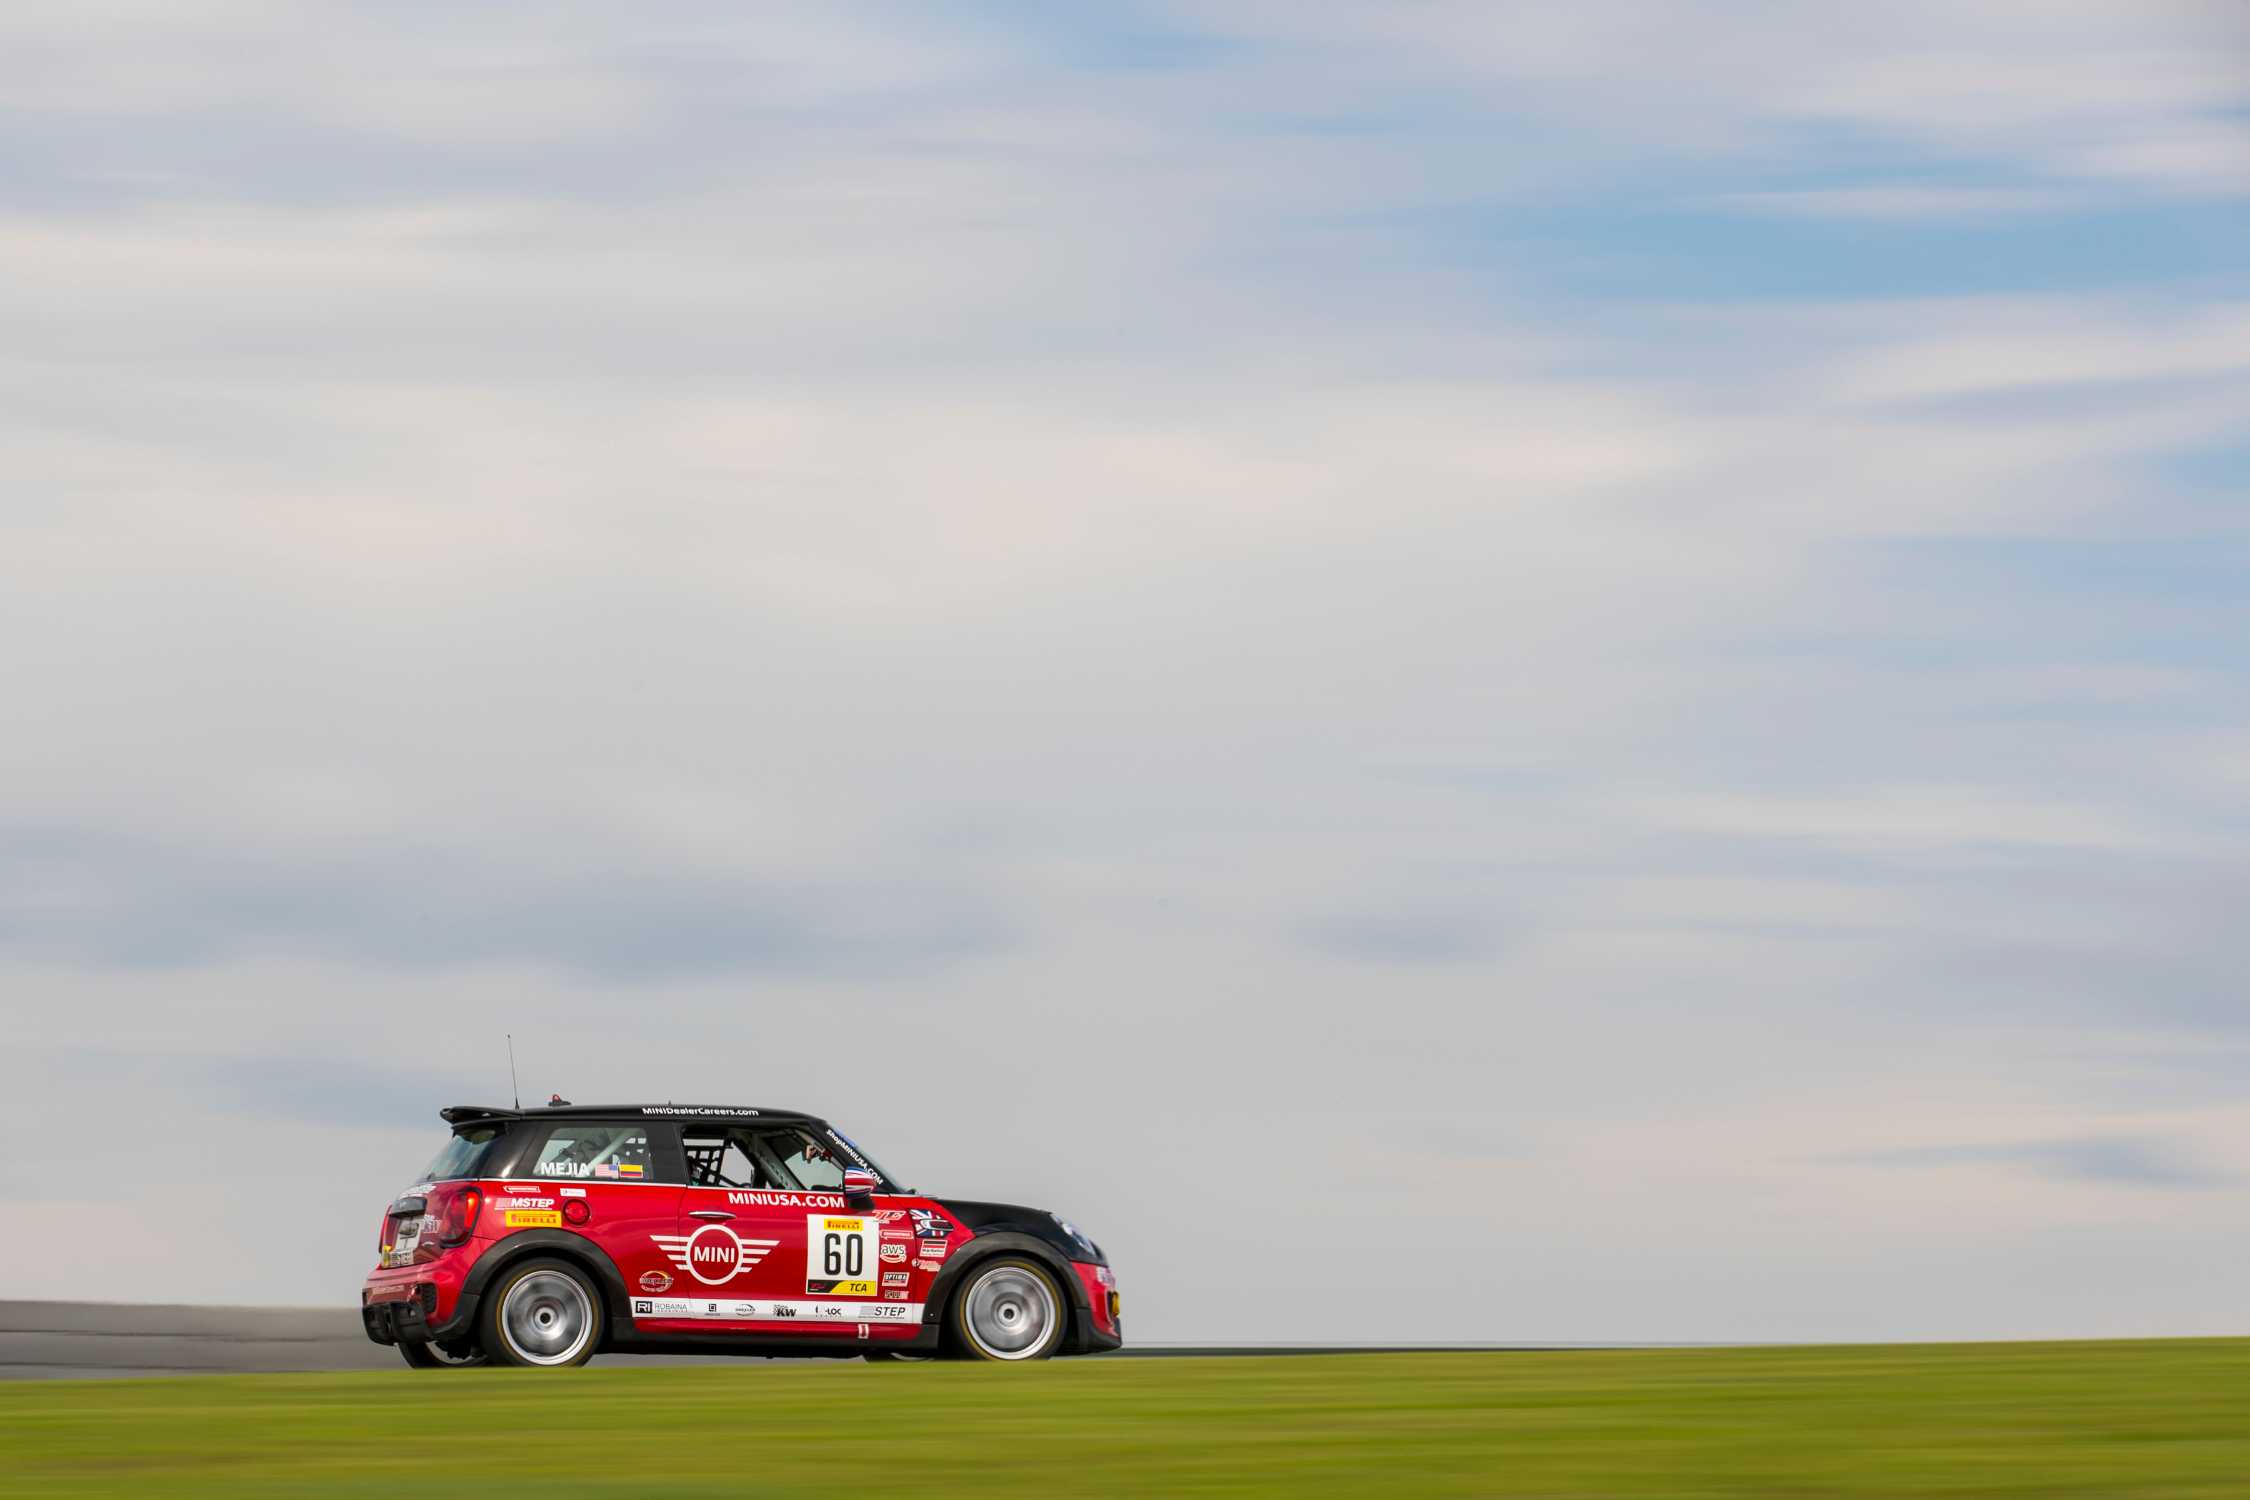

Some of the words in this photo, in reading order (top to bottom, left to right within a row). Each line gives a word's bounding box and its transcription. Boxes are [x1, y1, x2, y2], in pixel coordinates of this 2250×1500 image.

[642, 1106, 760, 1117] MINIDealerCareers.com
[541, 1162, 590, 1177] MEJIA
[728, 1192, 845, 1208] MINIUSA.COM
[511, 1213, 556, 1224] PIRELLI
[693, 1246, 735, 1263] MINI
[824, 1233, 863, 1276] 60
[881, 1244, 905, 1256] aws
[850, 1283, 868, 1293] TCA
[636, 1301, 652, 1313] RI
[776, 1308, 797, 1317] KW
